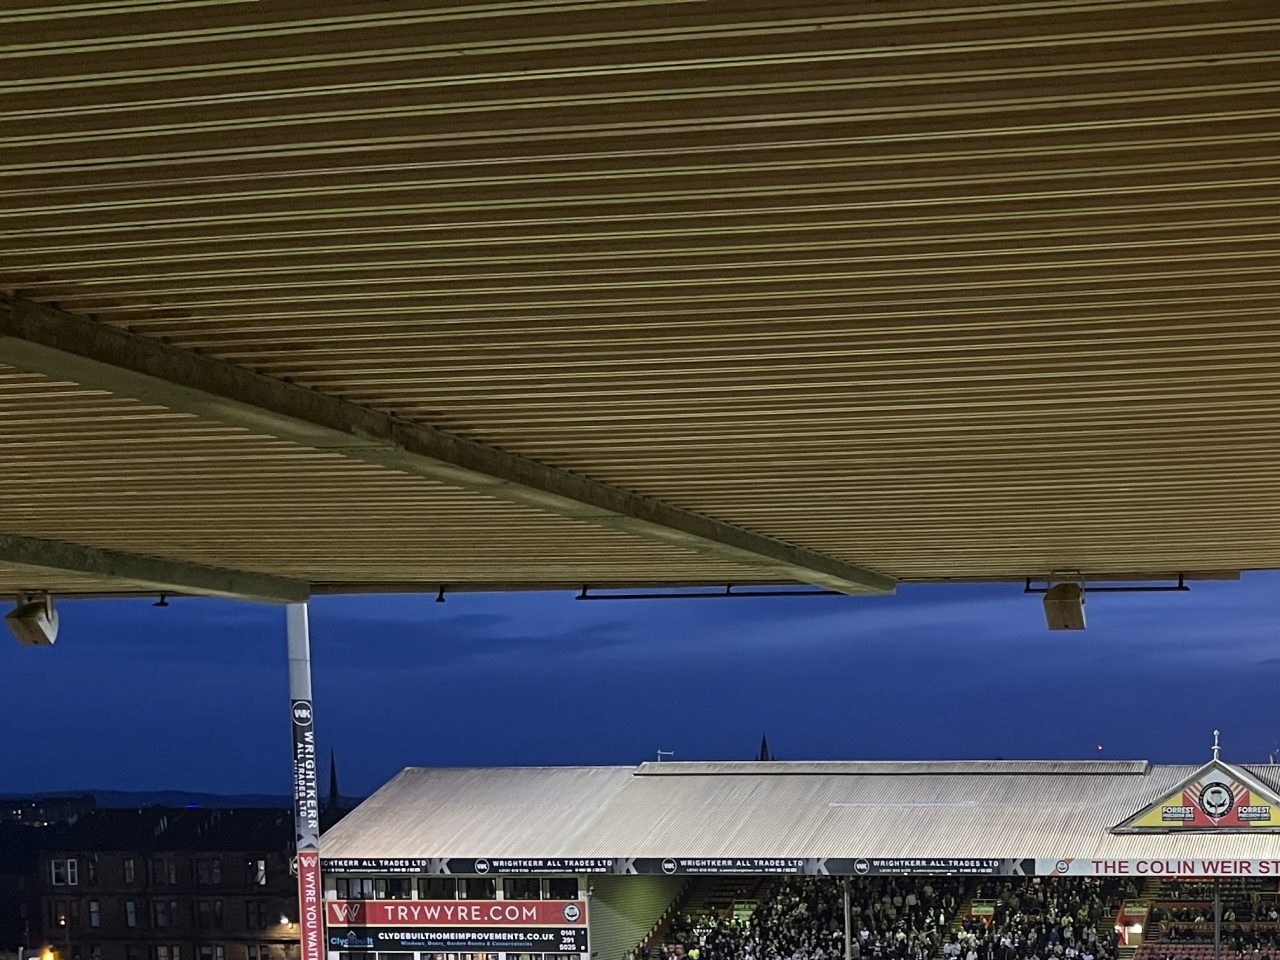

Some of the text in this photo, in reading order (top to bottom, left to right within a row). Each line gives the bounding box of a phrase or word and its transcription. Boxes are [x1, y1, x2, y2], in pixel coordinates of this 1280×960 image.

[294, 709, 311, 719] WK
[297, 742, 305, 760] ALL
[297, 762, 306, 799] TRADES
[304, 731, 317, 829] WRIGHTKERR
[1092, 860, 1130, 874] THE
[1136, 860, 1196, 874] COLIN
[1202, 860, 1252, 874] WEIR
[305, 872, 316, 903] WYRE
[306, 906, 317, 929] YOU
[384, 905, 537, 921] TRYWYRE.COM
[378, 932, 554, 940] CLYDEBUILTHOMEIMPROVEMENTS.CO.UK
